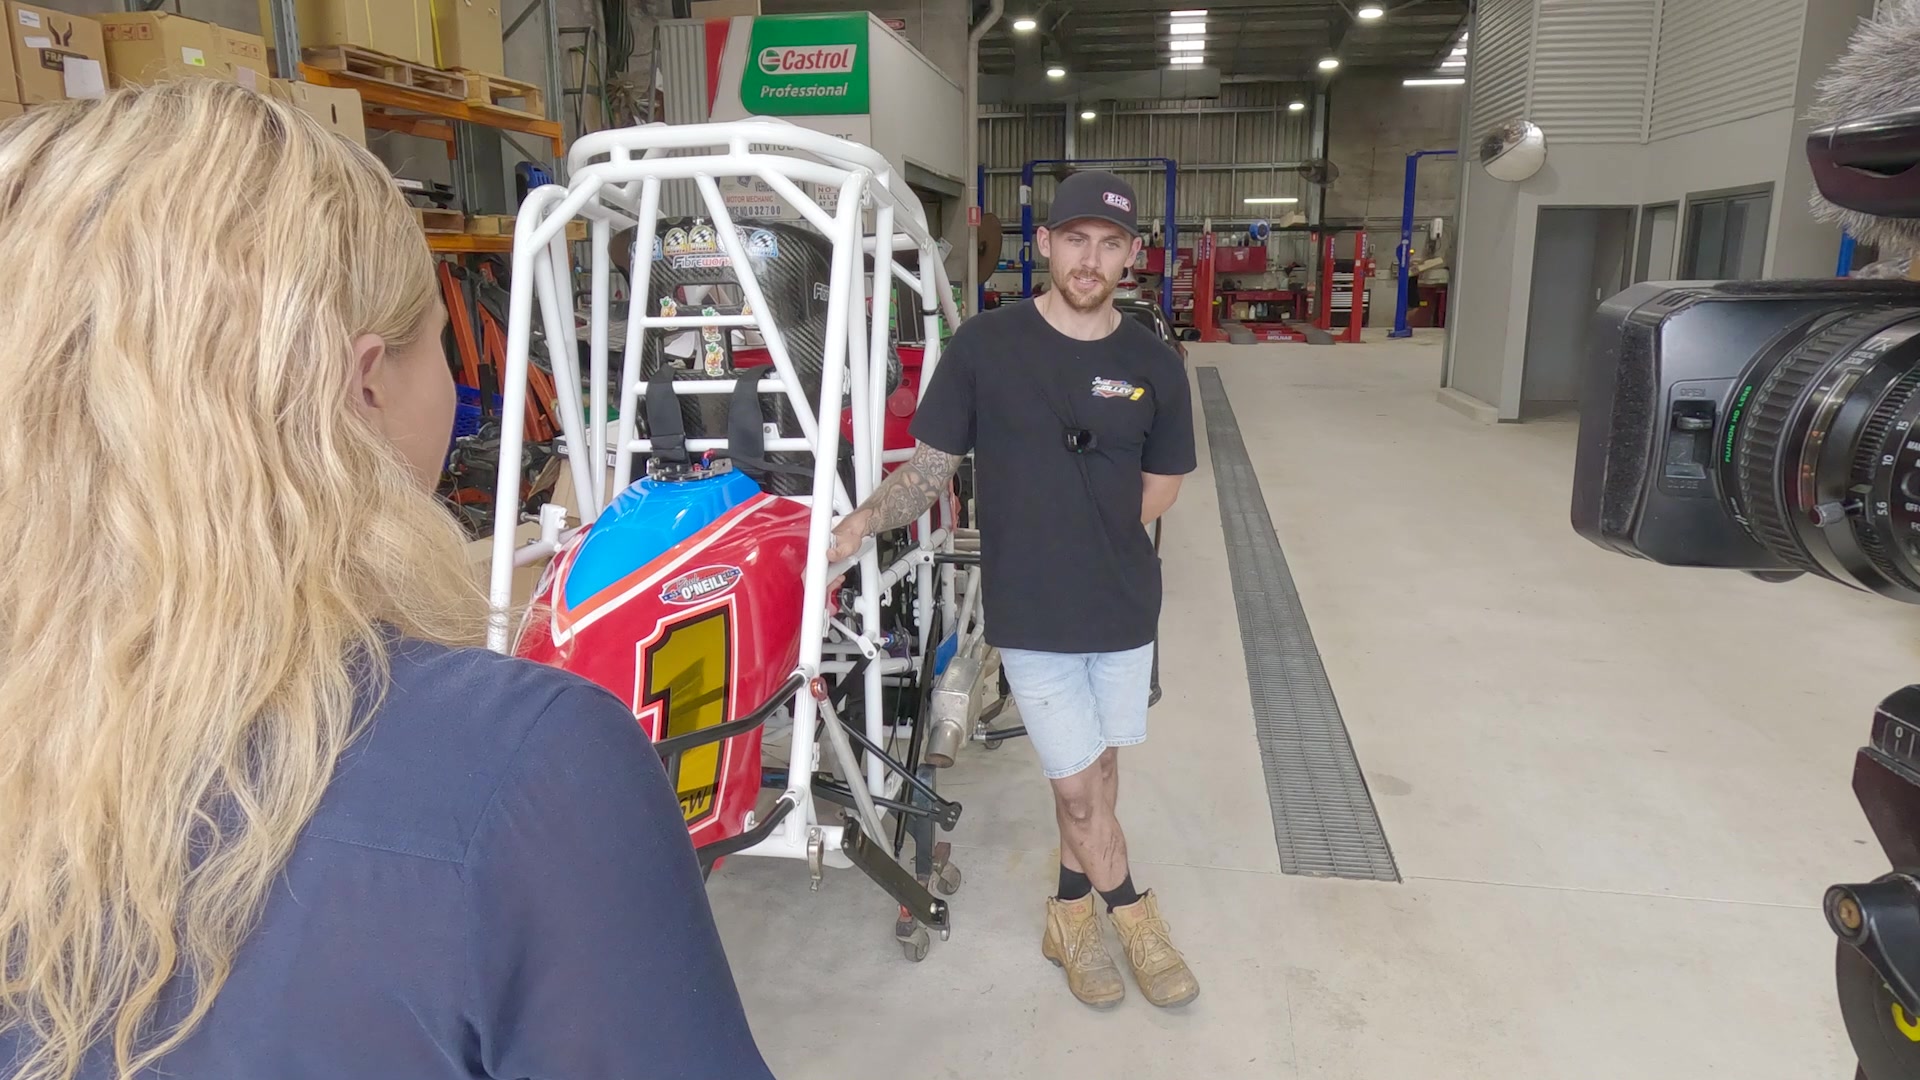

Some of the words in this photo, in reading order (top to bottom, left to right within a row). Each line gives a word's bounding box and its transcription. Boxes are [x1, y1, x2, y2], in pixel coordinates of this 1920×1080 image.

[782, 48, 849, 70] Castrol
[760, 82, 849, 98] Professional
[726, 195, 745, 203] MOTOR
[746, 195, 774, 203] MECHANIC
[748, 205, 781, 216] 032700
[674, 255, 729, 268] Fibrework
[1725, 425, 1735, 463] FUJINON
[1732, 410, 1740, 423] HD
[1737, 385, 1752, 407] LENS
[1896, 421, 1910, 431] 15
[1881, 454, 1894, 466] 10
[1876, 501, 1888, 516] 5.6
[681, 574, 728, 600] O'NEILL
[1895, 726, 1904, 738] 0
